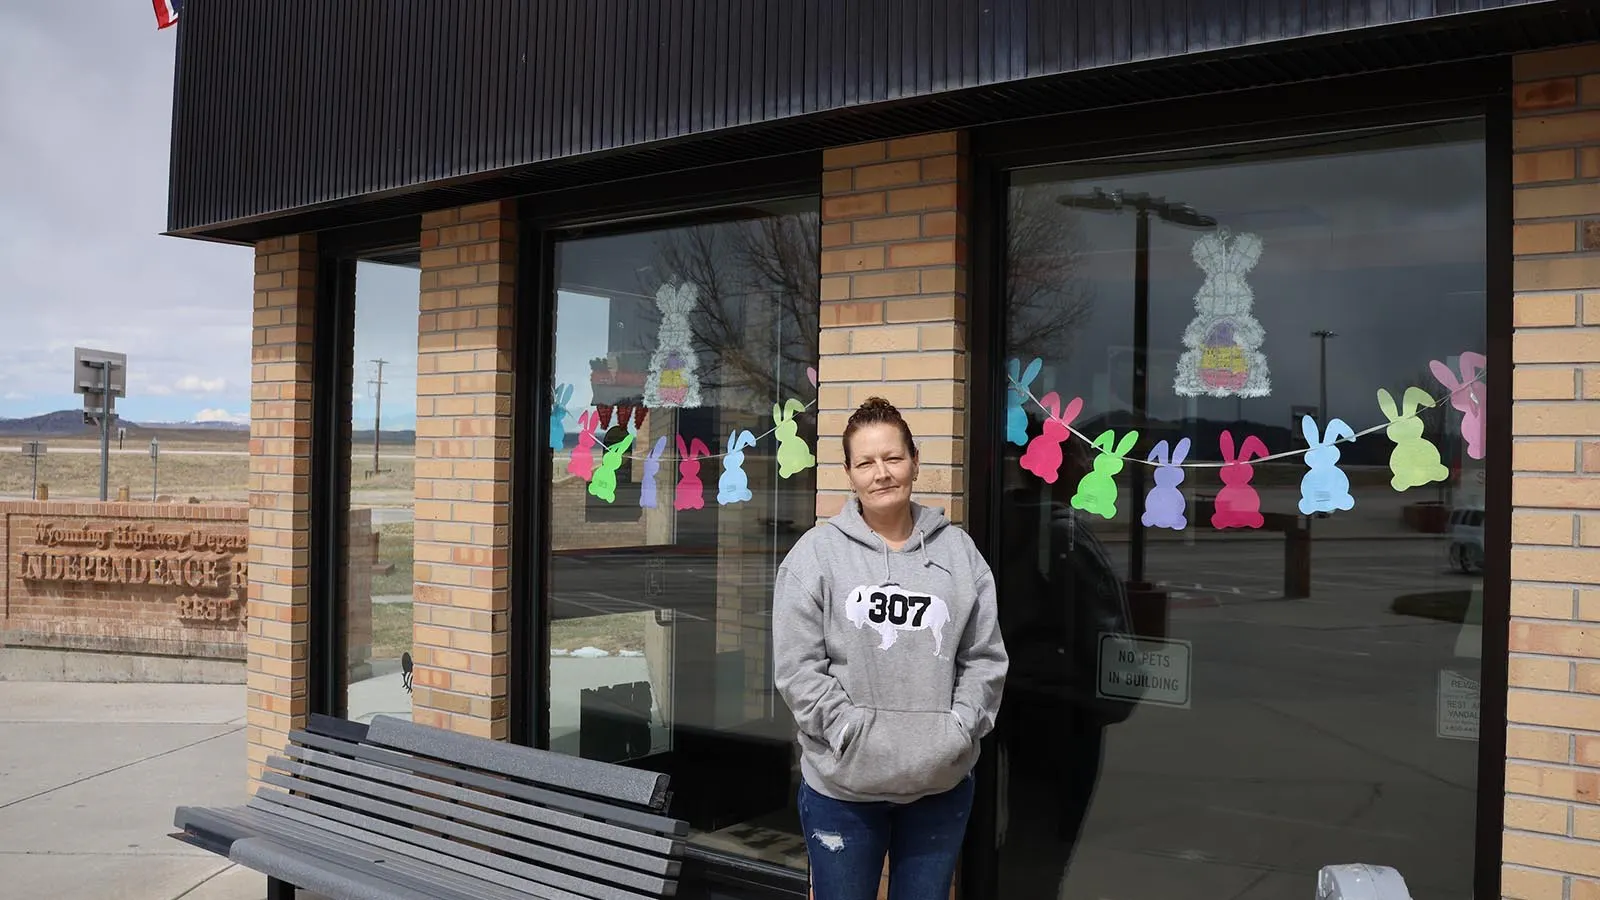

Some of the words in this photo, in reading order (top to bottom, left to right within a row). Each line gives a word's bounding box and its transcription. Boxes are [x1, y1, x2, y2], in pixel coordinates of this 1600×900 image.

[35, 522, 107, 549] Wyoming
[116, 524, 186, 551] Highway
[190, 529, 248, 553] Depar
[176, 597, 231, 621] REST
[868, 591, 932, 627] 307
[1118, 649, 1135, 664] NO
[1142, 652, 1171, 668] PETS
[1108, 671, 1120, 684] IN
[1125, 672, 1179, 691] BUILDING
